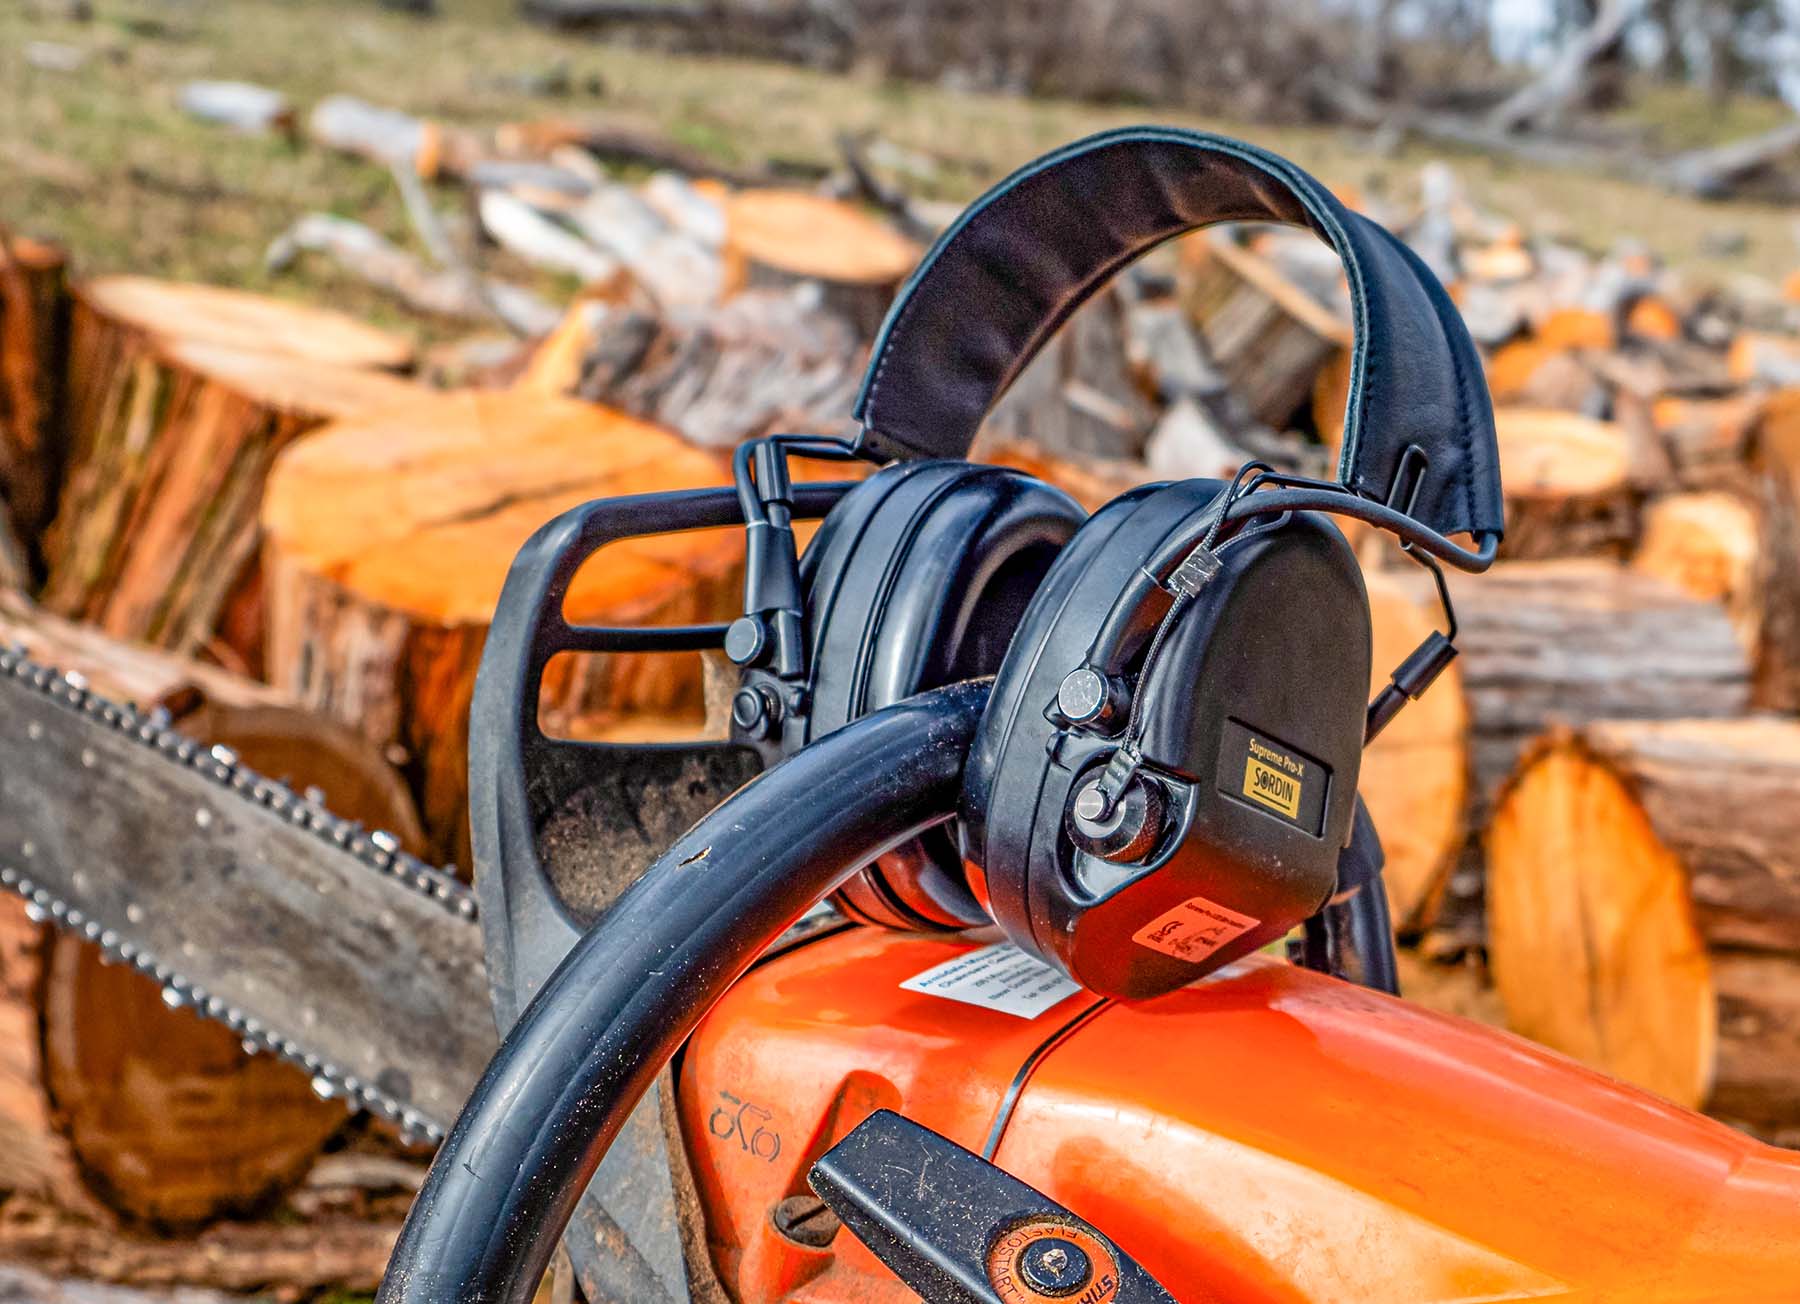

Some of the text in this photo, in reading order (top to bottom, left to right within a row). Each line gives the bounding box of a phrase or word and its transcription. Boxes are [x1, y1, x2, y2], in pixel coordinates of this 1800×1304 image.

[1248, 738, 1304, 777] Supreme Pro-X
[1253, 766, 1294, 803] SORDIN
[1076, 1273, 1114, 1304] STIH
